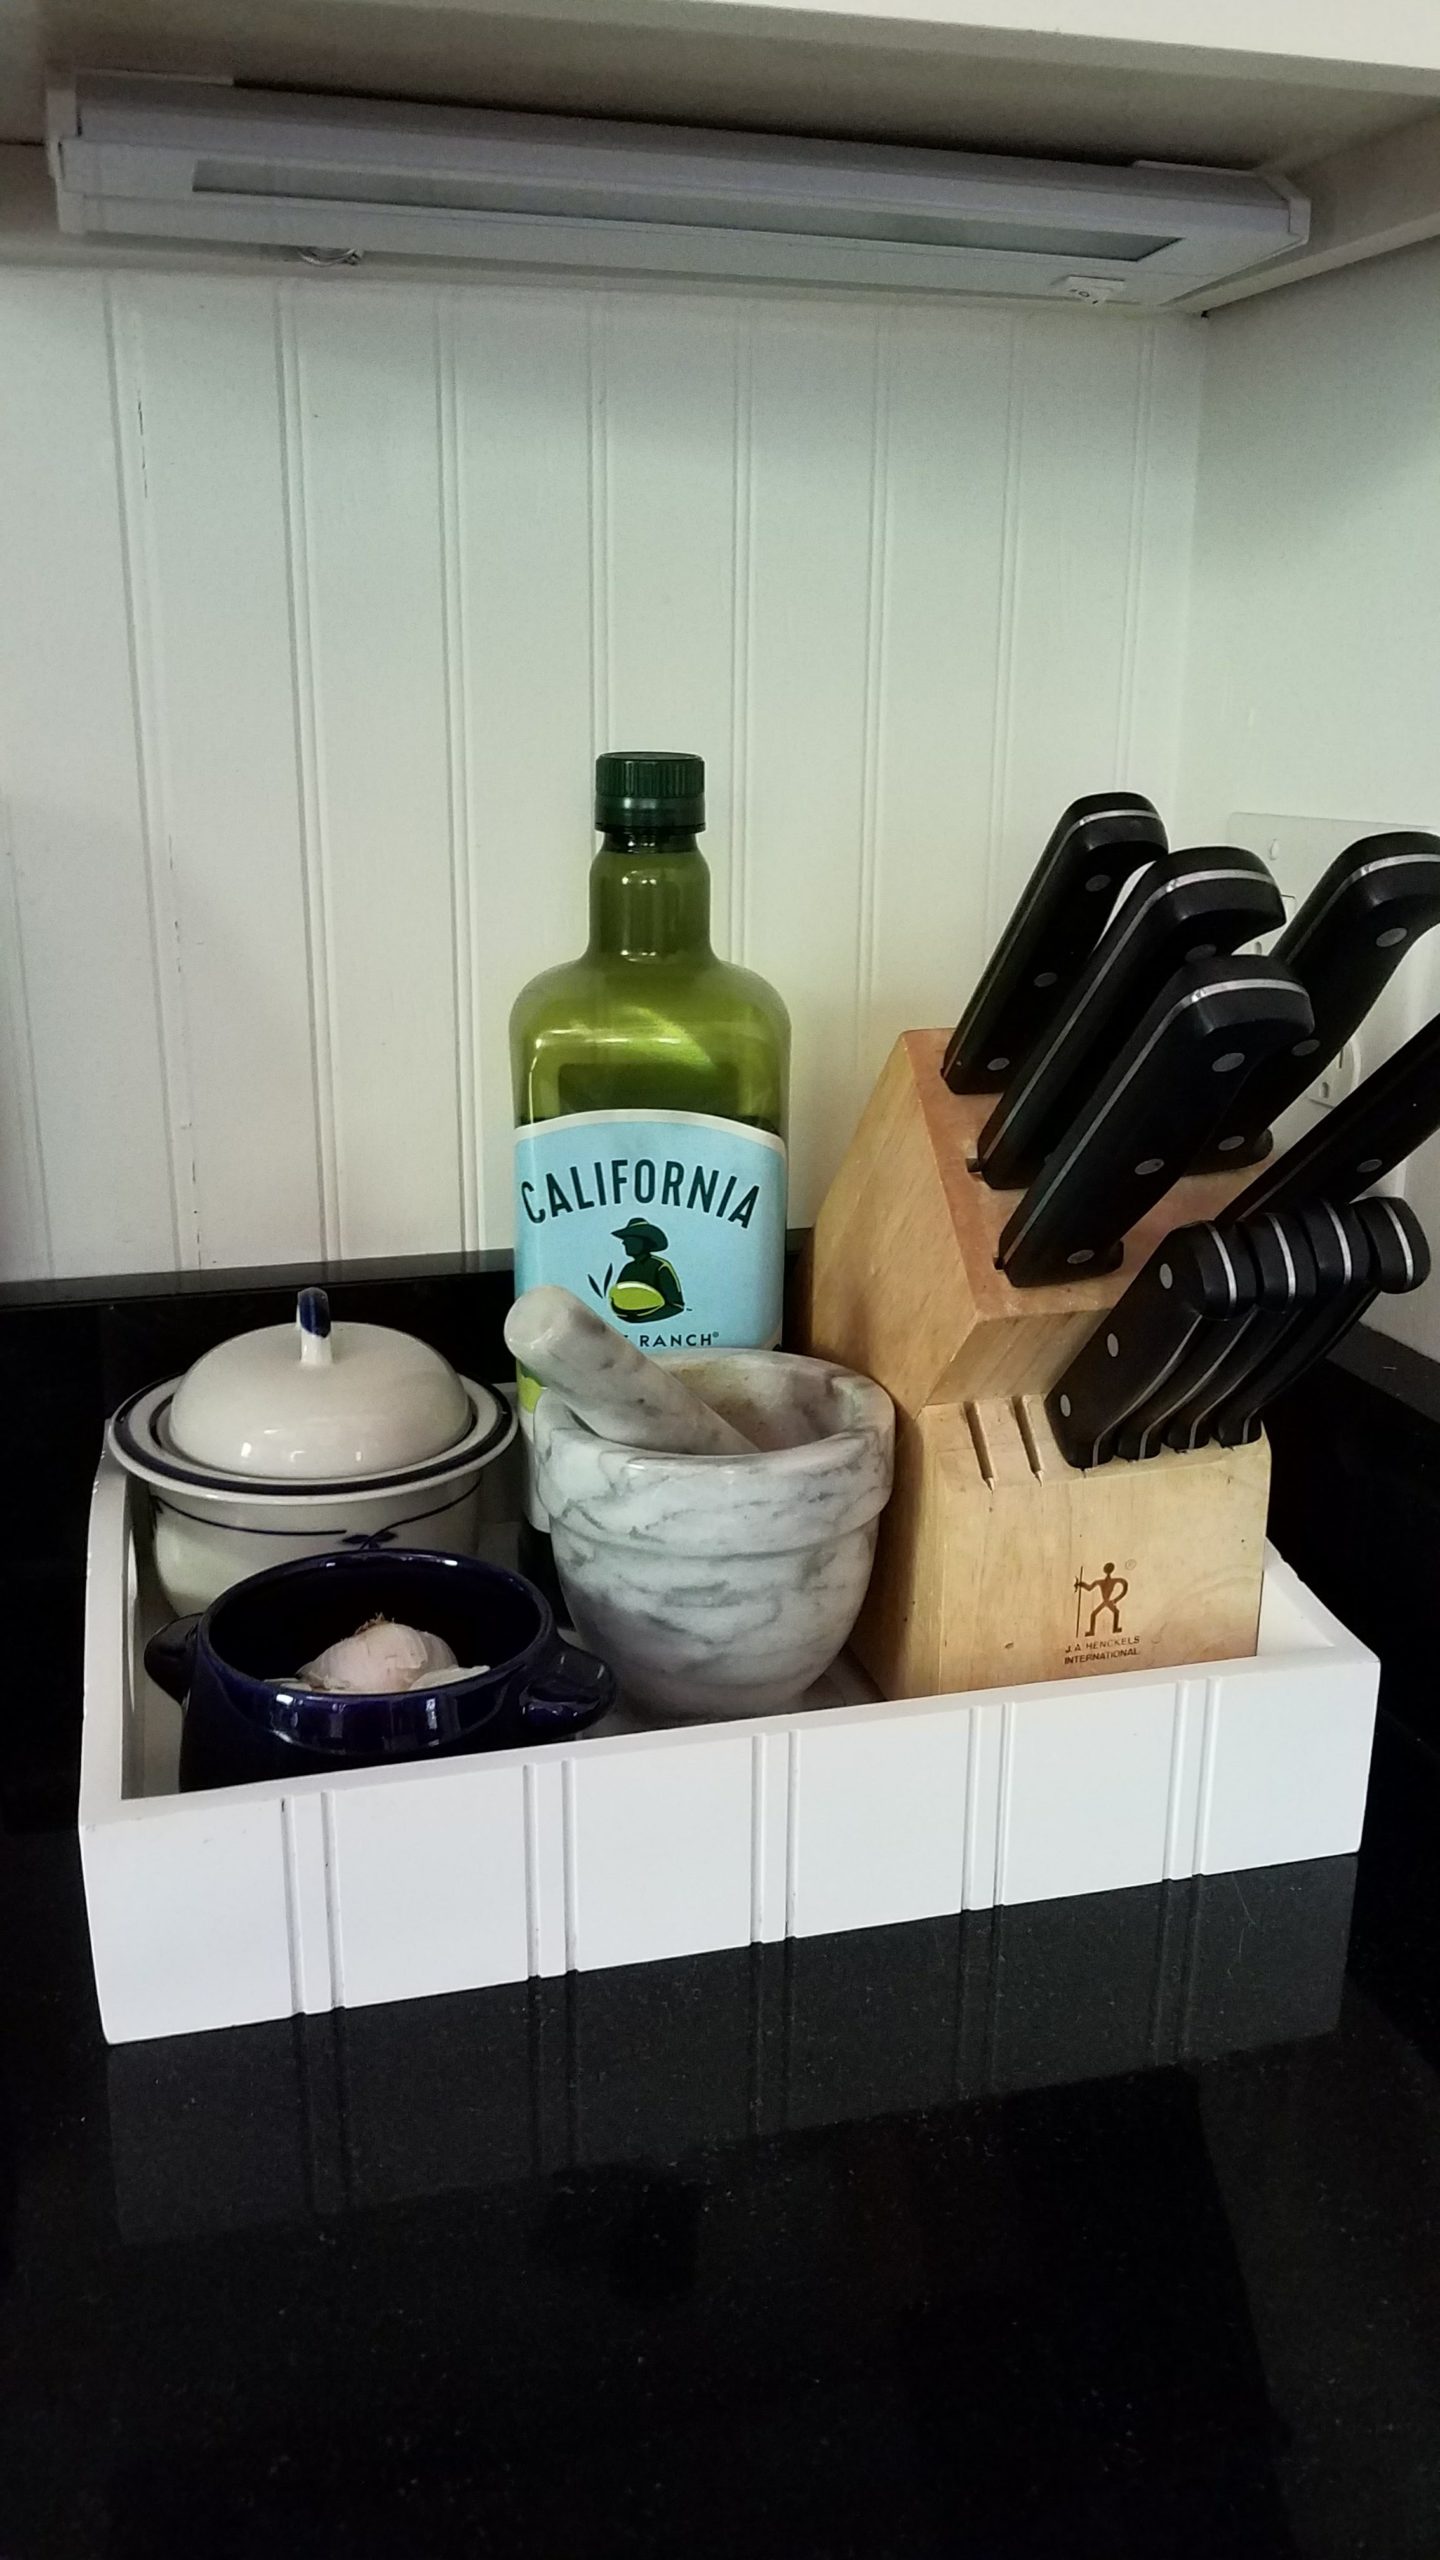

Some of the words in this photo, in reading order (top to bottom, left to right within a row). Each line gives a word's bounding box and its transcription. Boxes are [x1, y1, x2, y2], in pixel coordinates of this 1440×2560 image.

[520, 1159, 760, 1229] CALIFORNIA
[1085, 1636, 1140, 1650] HENCKELS
[1064, 1647, 1138, 1664] INTERNATIONAL
